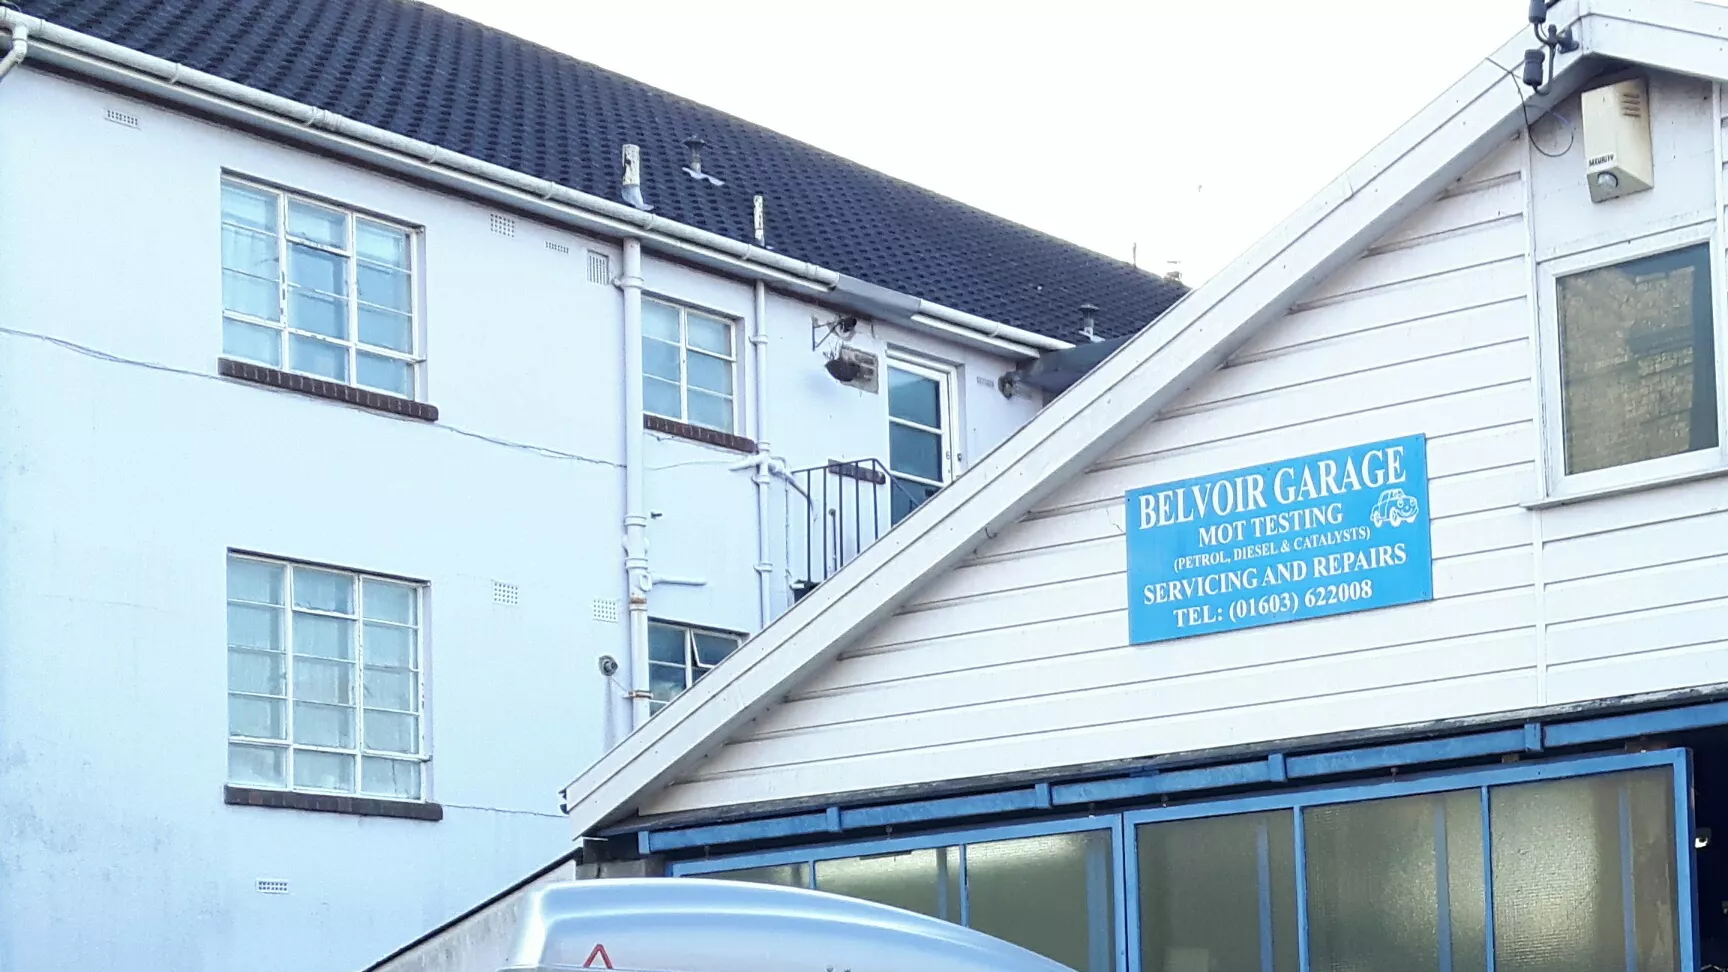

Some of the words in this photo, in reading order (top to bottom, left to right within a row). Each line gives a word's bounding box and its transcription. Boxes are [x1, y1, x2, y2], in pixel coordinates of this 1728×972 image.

[1138, 473, 1268, 530] BELVOIR
[1273, 446, 1406, 504] GARAGE
[1174, 549, 1231, 573] (PETROL,
[1234, 542, 1278, 561] DIESEL
[1280, 539, 1291, 553] &
[1294, 525, 1371, 550] CATALYSTS)
[1199, 521, 1246, 548] MOT
[1251, 503, 1344, 537] TESTING
[1144, 568, 1258, 605] SERVICING
[1262, 560, 1307, 586] AND
[1313, 543, 1407, 578] REPAIRS
[1173, 604, 1223, 628] TEL:
[1229, 591, 1299, 623] (01603)
[1304, 579, 1373, 608] 622008
